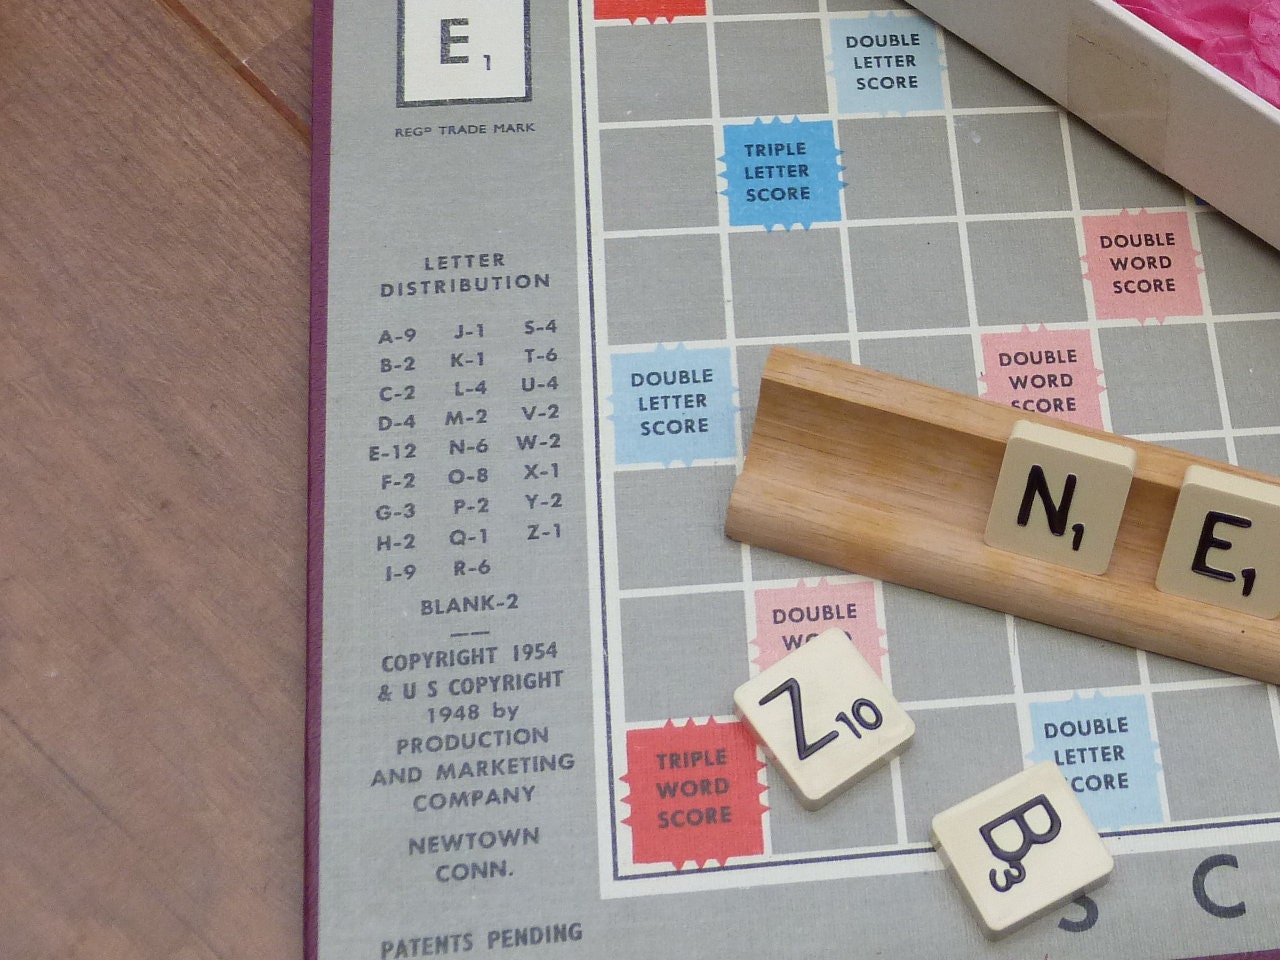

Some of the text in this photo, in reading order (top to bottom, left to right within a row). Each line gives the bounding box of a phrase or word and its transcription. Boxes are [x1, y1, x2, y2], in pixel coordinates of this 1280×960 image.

[846, 34, 920, 48] DOUBLE
[854, 55, 916, 69] LETTER
[857, 76, 917, 90] SCORE
[438, 125, 486, 135] TRADE
[494, 123, 535, 133] MARK
[744, 143, 806, 157] TRIPLE
[745, 164, 809, 179] LETTER
[747, 187, 810, 202] SCORE
[1100, 233, 1175, 248] DOUBLE
[425, 253, 504, 270] LETTER
[1110, 256, 1171, 271] WORD
[381, 274, 549, 297] DISTRIBUTION
[1113, 279, 1175, 294] SCORE
[378, 320, 557, 344] A-9 J-1 S-4
[381, 348, 557, 372] B-2 K-1 T-6
[999, 350, 1077, 366] DOUBLE
[632, 369, 712, 387] DOUBLE
[1009, 374, 1072, 389] WORD
[380, 376, 558, 402] C-2 L-4 U-4
[639, 394, 706, 411] LETTER
[379, 404, 559, 431] D-4 M-2 V-2
[641, 418, 708, 436] SCORE
[369, 433, 560, 461] E-12 N-6 W-2
[382, 463, 558, 490] F-2 O-8 X-1
[376, 493, 562, 520] G-3 P-2 Y-2
[377, 524, 560, 551] H-2 Q-1 Z-1
[386, 559, 490, 581] I-9 R-6
[421, 594, 518, 615] BLANK-2
[773, 603, 856, 624] DOUBLE
[382, 642, 557, 672] COPYRIGHT 1954
[378, 670, 563, 702] & U S COPYRIGHT
[428, 702, 519, 723] 1948 by
[1045, 717, 1128, 738] DOUBLE
[397, 727, 548, 755] PRODUCTION
[656, 748, 727, 770] TRIPLE
[1055, 745, 1125, 765] LETTER
[371, 753, 575, 787] AND MARKETING
[656, 778, 729, 799] WORD
[1071, 773, 1128, 792] CORE
[413, 786, 535, 812] COMPANY
[658, 806, 732, 828] SCORE
[409, 827, 539, 855] NEWTOWN
[436, 860, 513, 883] CONN.
[381, 923, 582, 960] PATENTS PENDING
